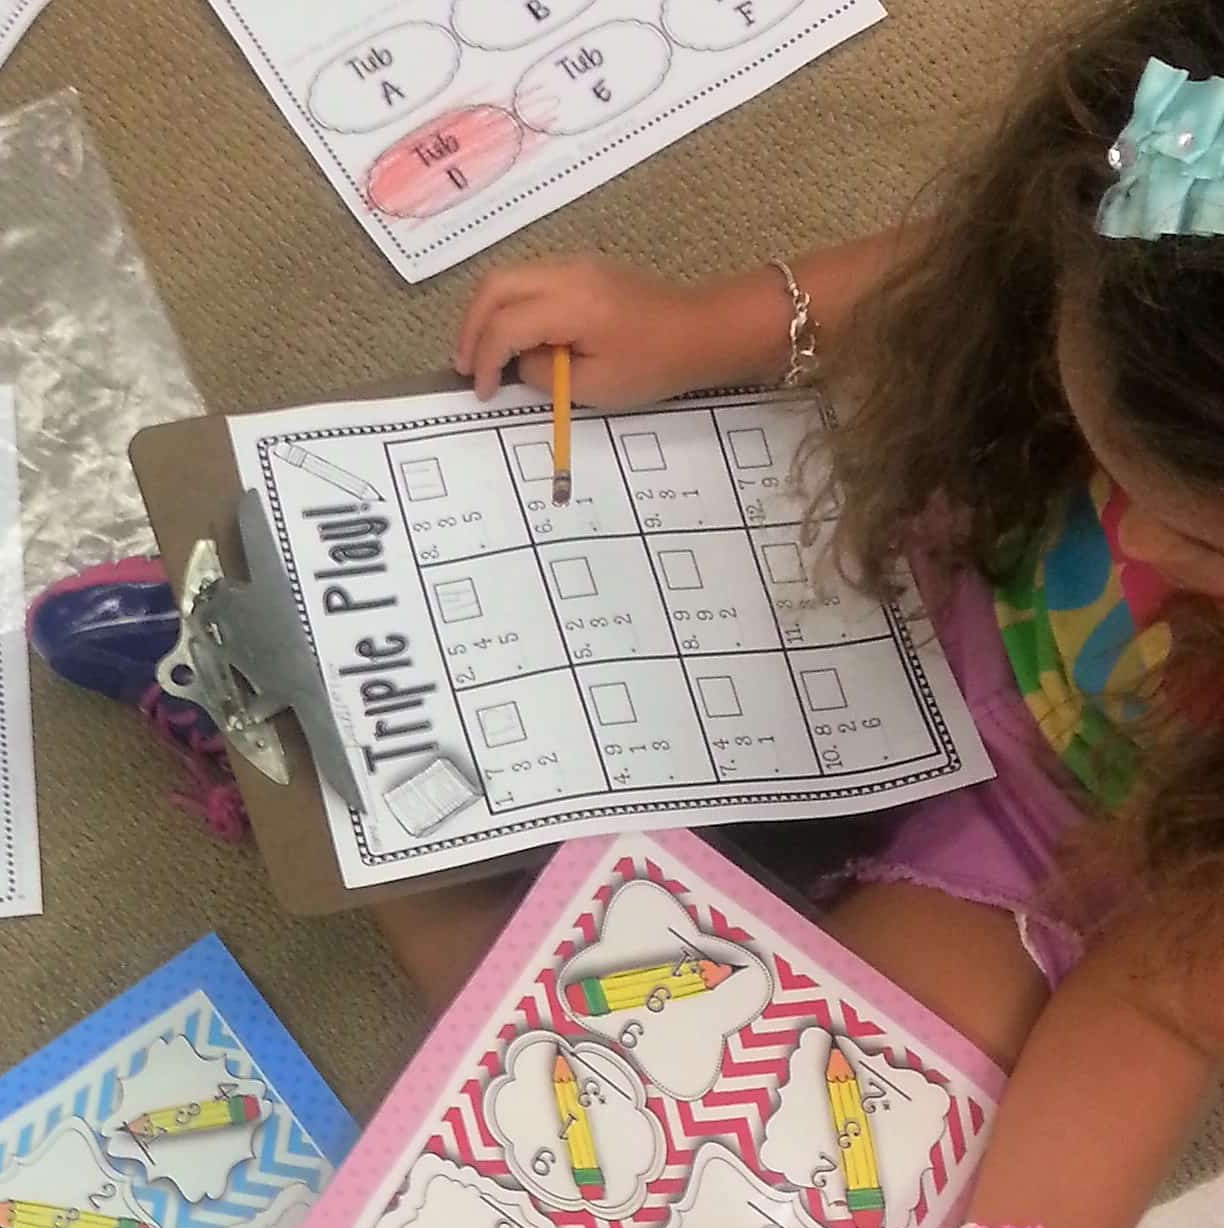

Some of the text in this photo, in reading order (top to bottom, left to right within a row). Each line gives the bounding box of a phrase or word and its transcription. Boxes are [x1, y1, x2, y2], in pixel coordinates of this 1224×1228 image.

[526, 0, 551, 22] B
[734, 0, 757, 27] F
[348, 47, 394, 80] Tub
[556, 46, 605, 80] Tub
[382, 80, 406, 106] A
[591, 79, 613, 104] E
[413, 132, 461, 168] Tub
[446, 166, 469, 190] D
[737, 478, 756, 491] 7
[761, 476, 779, 488] 9
[575, 496, 593, 506] 1
[659, 488, 677, 500] 3
[682, 489, 700, 499] 1
[527, 500, 546, 511] 9
[635, 488, 663, 529] 9. 2
[462, 511, 482, 523] 5
[589, 616, 609, 628] 3
[613, 612, 633, 625] 2
[673, 609, 691, 621] 9
[696, 609, 714, 621] 9
[719, 606, 738, 619] 2
[301, 502, 439, 774] Triple Play!
[473, 638, 493, 650] 4
[498, 632, 519, 645] 5
[566, 618, 593, 660] 5. 2
[785, 623, 804, 644] 11.
[447, 643, 476, 684] 2. 5
[837, 720, 857, 733] 2
[862, 717, 882, 730] 6
[603, 743, 624, 756] 9
[629, 743, 647, 754] 1
[652, 739, 671, 751] 3
[758, 734, 775, 745] 1
[815, 724, 843, 770] 10. 8
[511, 760, 532, 772] 3
[538, 751, 559, 766] 2
[712, 738, 737, 777] 7. 4
[485, 768, 505, 781] 7
[672, 949, 691, 978] 1
[646, 986, 672, 1013] 9
[620, 1021, 645, 1049] 9
[214, 1082, 240, 1102] 4
[577, 1079, 601, 1108] 3
[861, 1080, 888, 1115] 2
[174, 1102, 202, 1126] 3
[559, 1113, 579, 1141] 1
[837, 1120, 861, 1150] 3
[532, 1149, 557, 1176] 9
[810, 1154, 839, 1188] 2
[87, 1183, 118, 1209] 2
